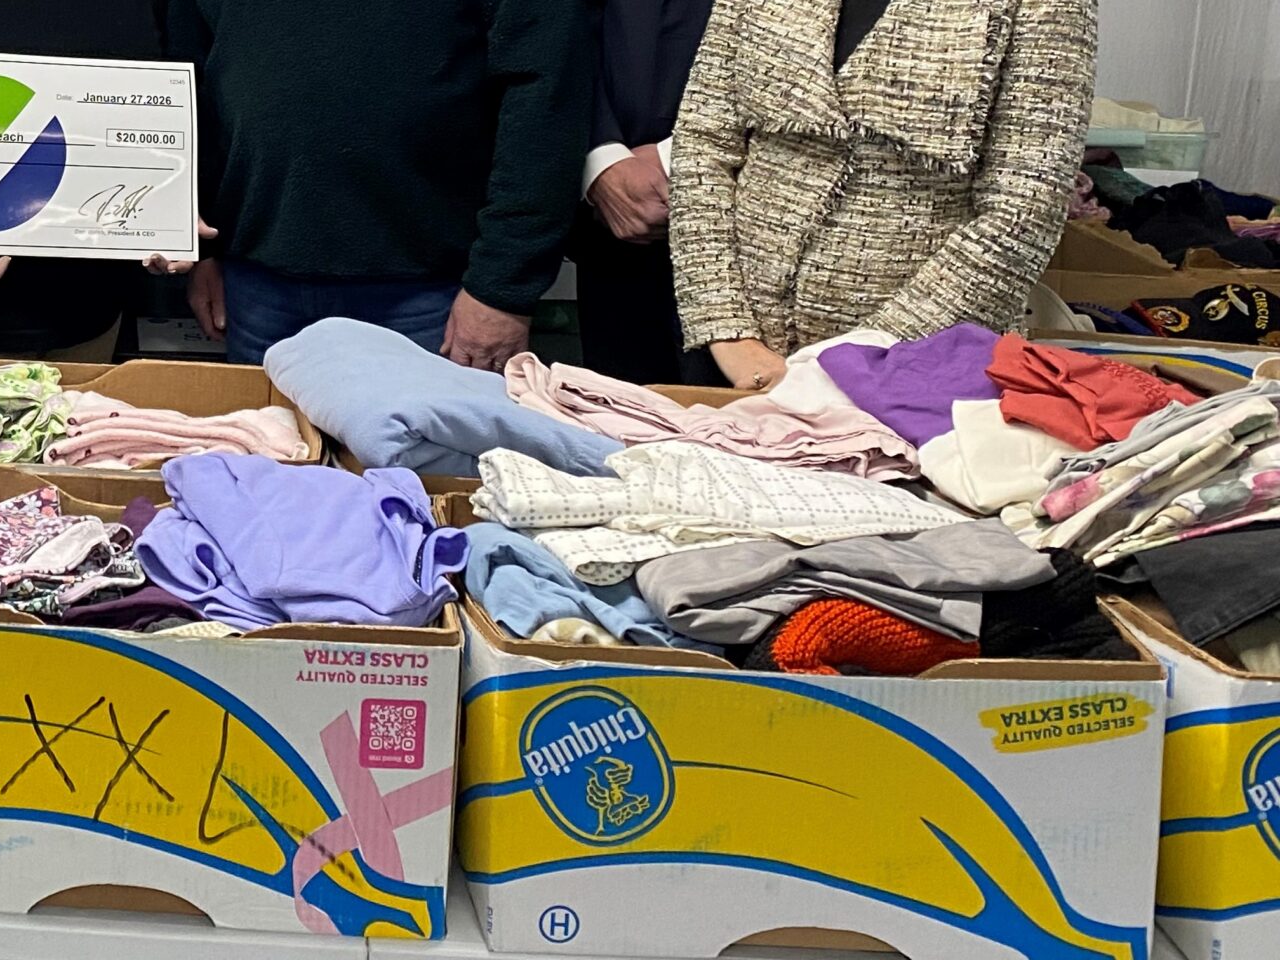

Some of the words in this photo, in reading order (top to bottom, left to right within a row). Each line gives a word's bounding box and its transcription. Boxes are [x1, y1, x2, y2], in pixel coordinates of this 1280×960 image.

[83, 92, 127, 104] January
[116, 132, 176, 145] $20,000.00
[1252, 291, 1269, 330] CIRCUS
[304, 649, 366, 666] EXTRA
[370, 652, 429, 669] CLASS
[296, 670, 356, 683] QUALITY
[360, 673, 429, 686] SELECTED
[1069, 696, 1128, 719] CLASS
[1000, 706, 1064, 728] EXTRA
[1066, 716, 1135, 736] SELECTED
[523, 706, 646, 777] Chiquita
[1001, 724, 1063, 745] QUALITY
